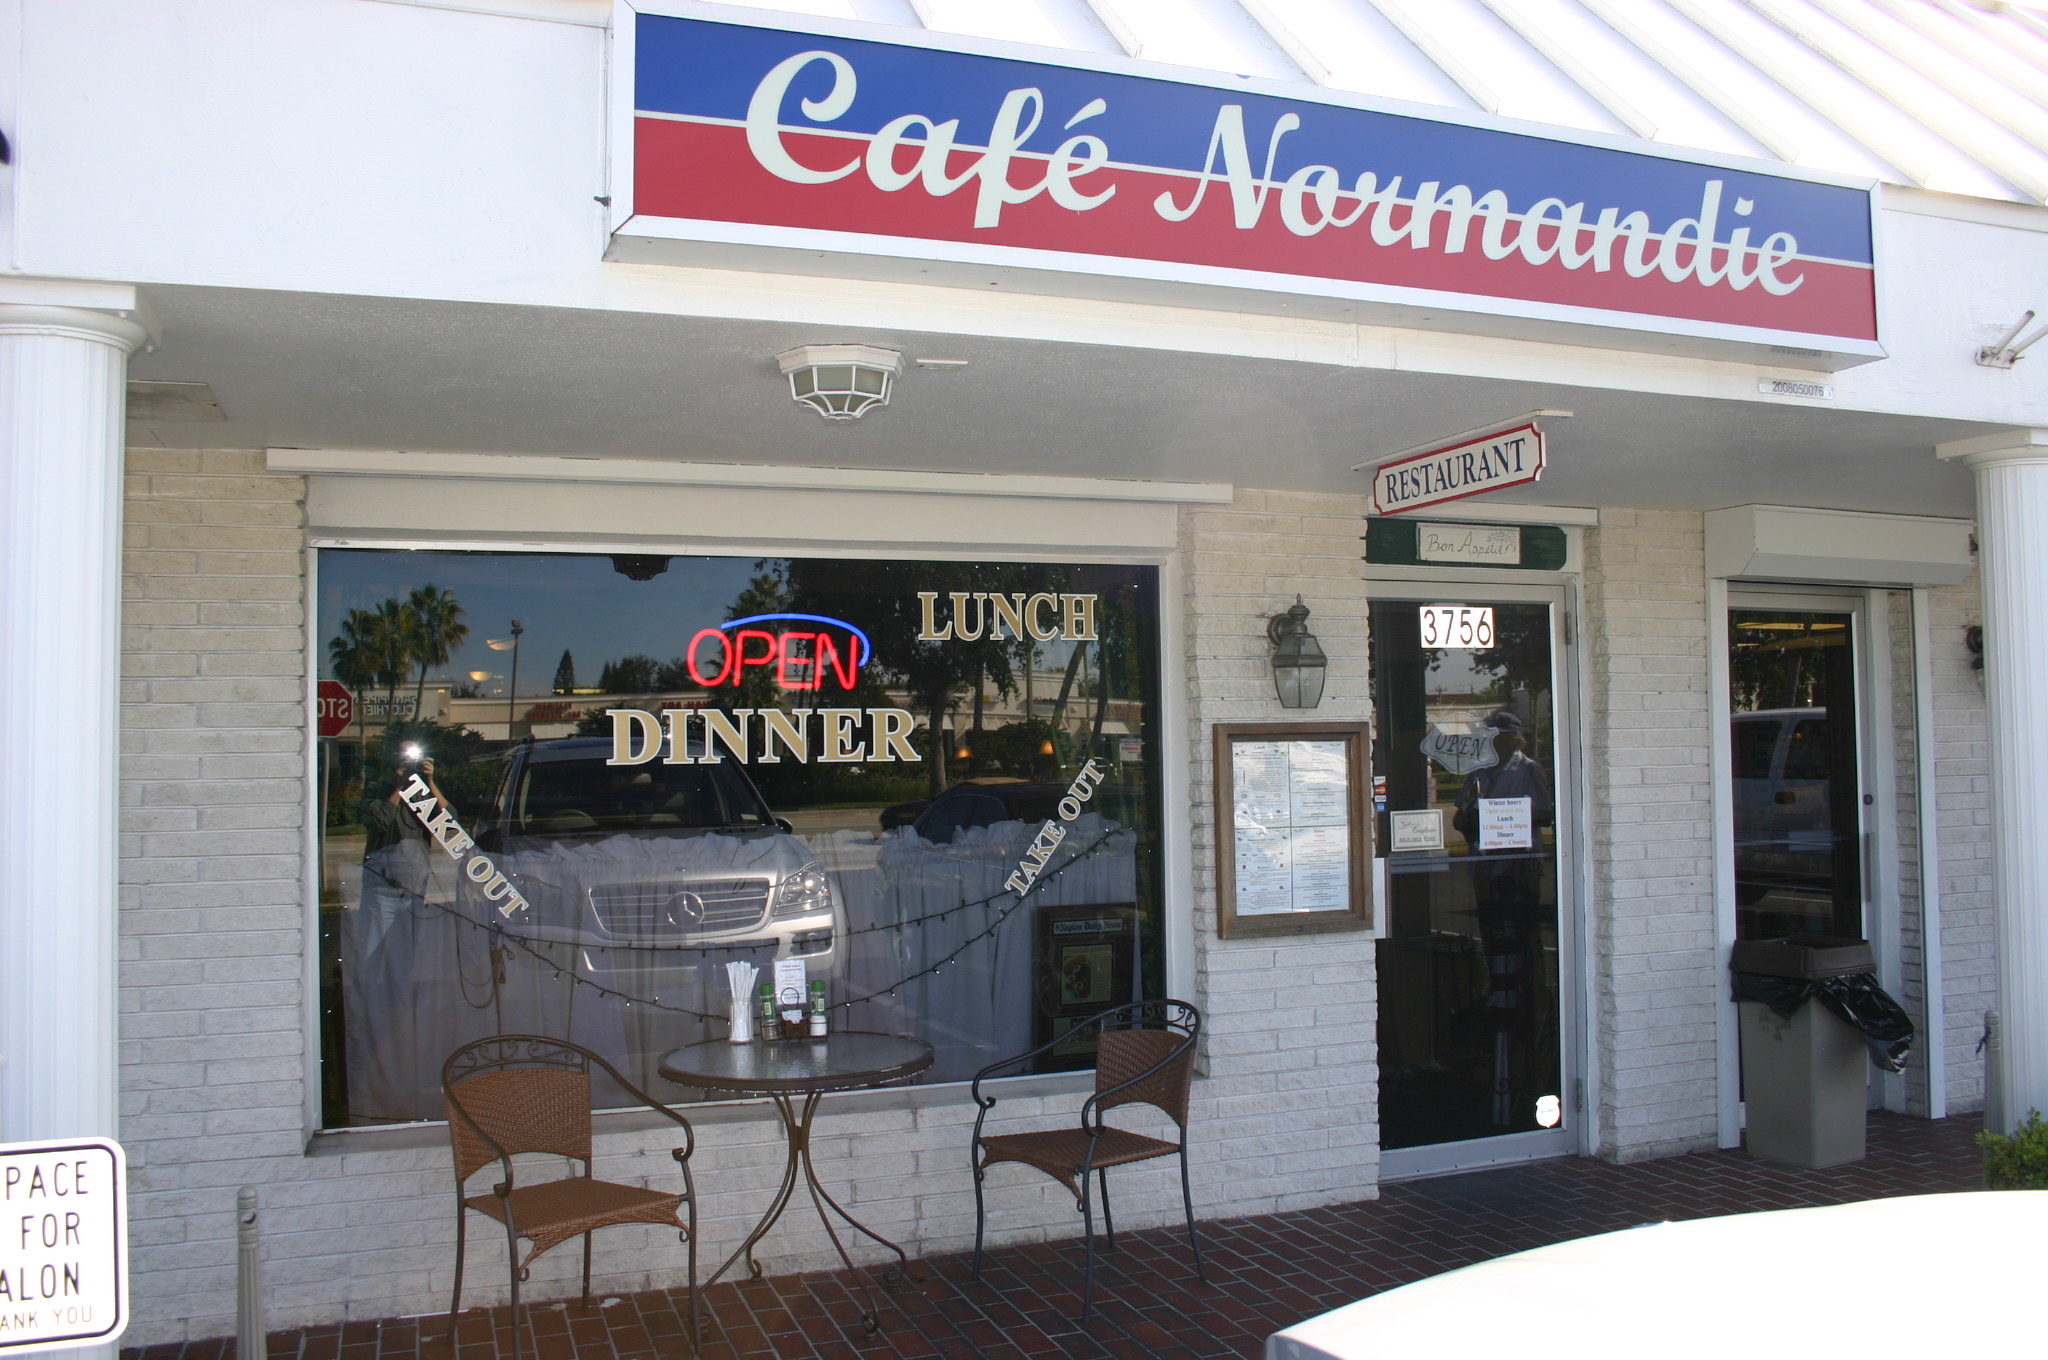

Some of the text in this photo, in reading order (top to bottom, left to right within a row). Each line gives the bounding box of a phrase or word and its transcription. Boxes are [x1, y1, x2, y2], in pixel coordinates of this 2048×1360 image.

[746, 50, 1804, 296] Café Normandie
[1772, 381, 1824, 397] 2008050076
[1385, 437, 1526, 504] RESTAURANT
[1427, 533, 1454, 553] Bon
[917, 591, 1098, 641] LUNCH
[1423, 609, 1492, 646] 3756
[687, 628, 858, 690] OPEN
[605, 708, 923, 766] DINNER
[1435, 733, 1487, 760] OPEN
[398, 773, 530, 919] TAKE OUT
[1004, 758, 1105, 897] TAKE OUT
[21, 1211, 81, 1250] FOR
[53, 1305, 93, 1328] YOU
